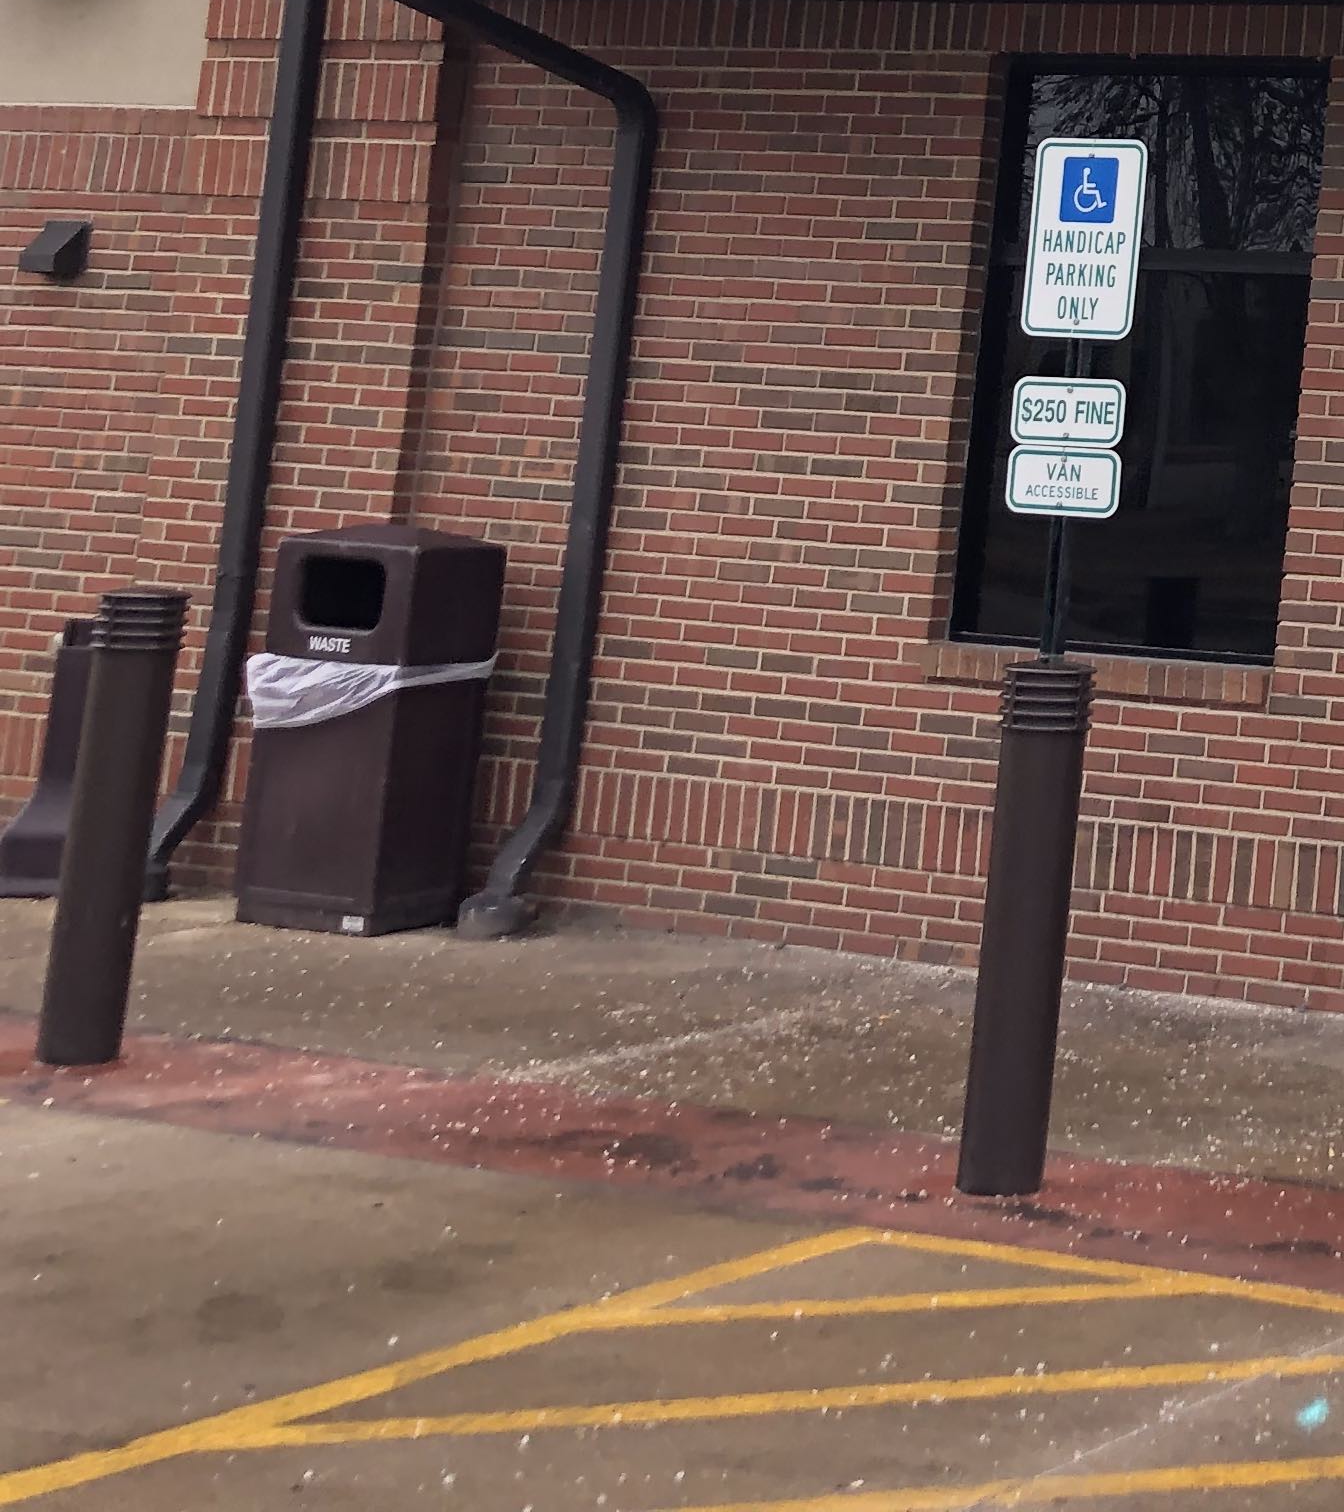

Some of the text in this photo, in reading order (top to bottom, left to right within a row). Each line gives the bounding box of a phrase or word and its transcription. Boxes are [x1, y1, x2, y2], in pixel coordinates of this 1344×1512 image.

[1042, 229, 1127, 256] HANDICAP
[1045, 263, 1117, 289] PARKING
[1056, 295, 1100, 321] ONLY
[1020, 396, 1116, 426] $250 FINE
[1046, 462, 1082, 483] VAN
[1025, 484, 1100, 501] ACCESSIBLE
[308, 635, 352, 654] WASTE
